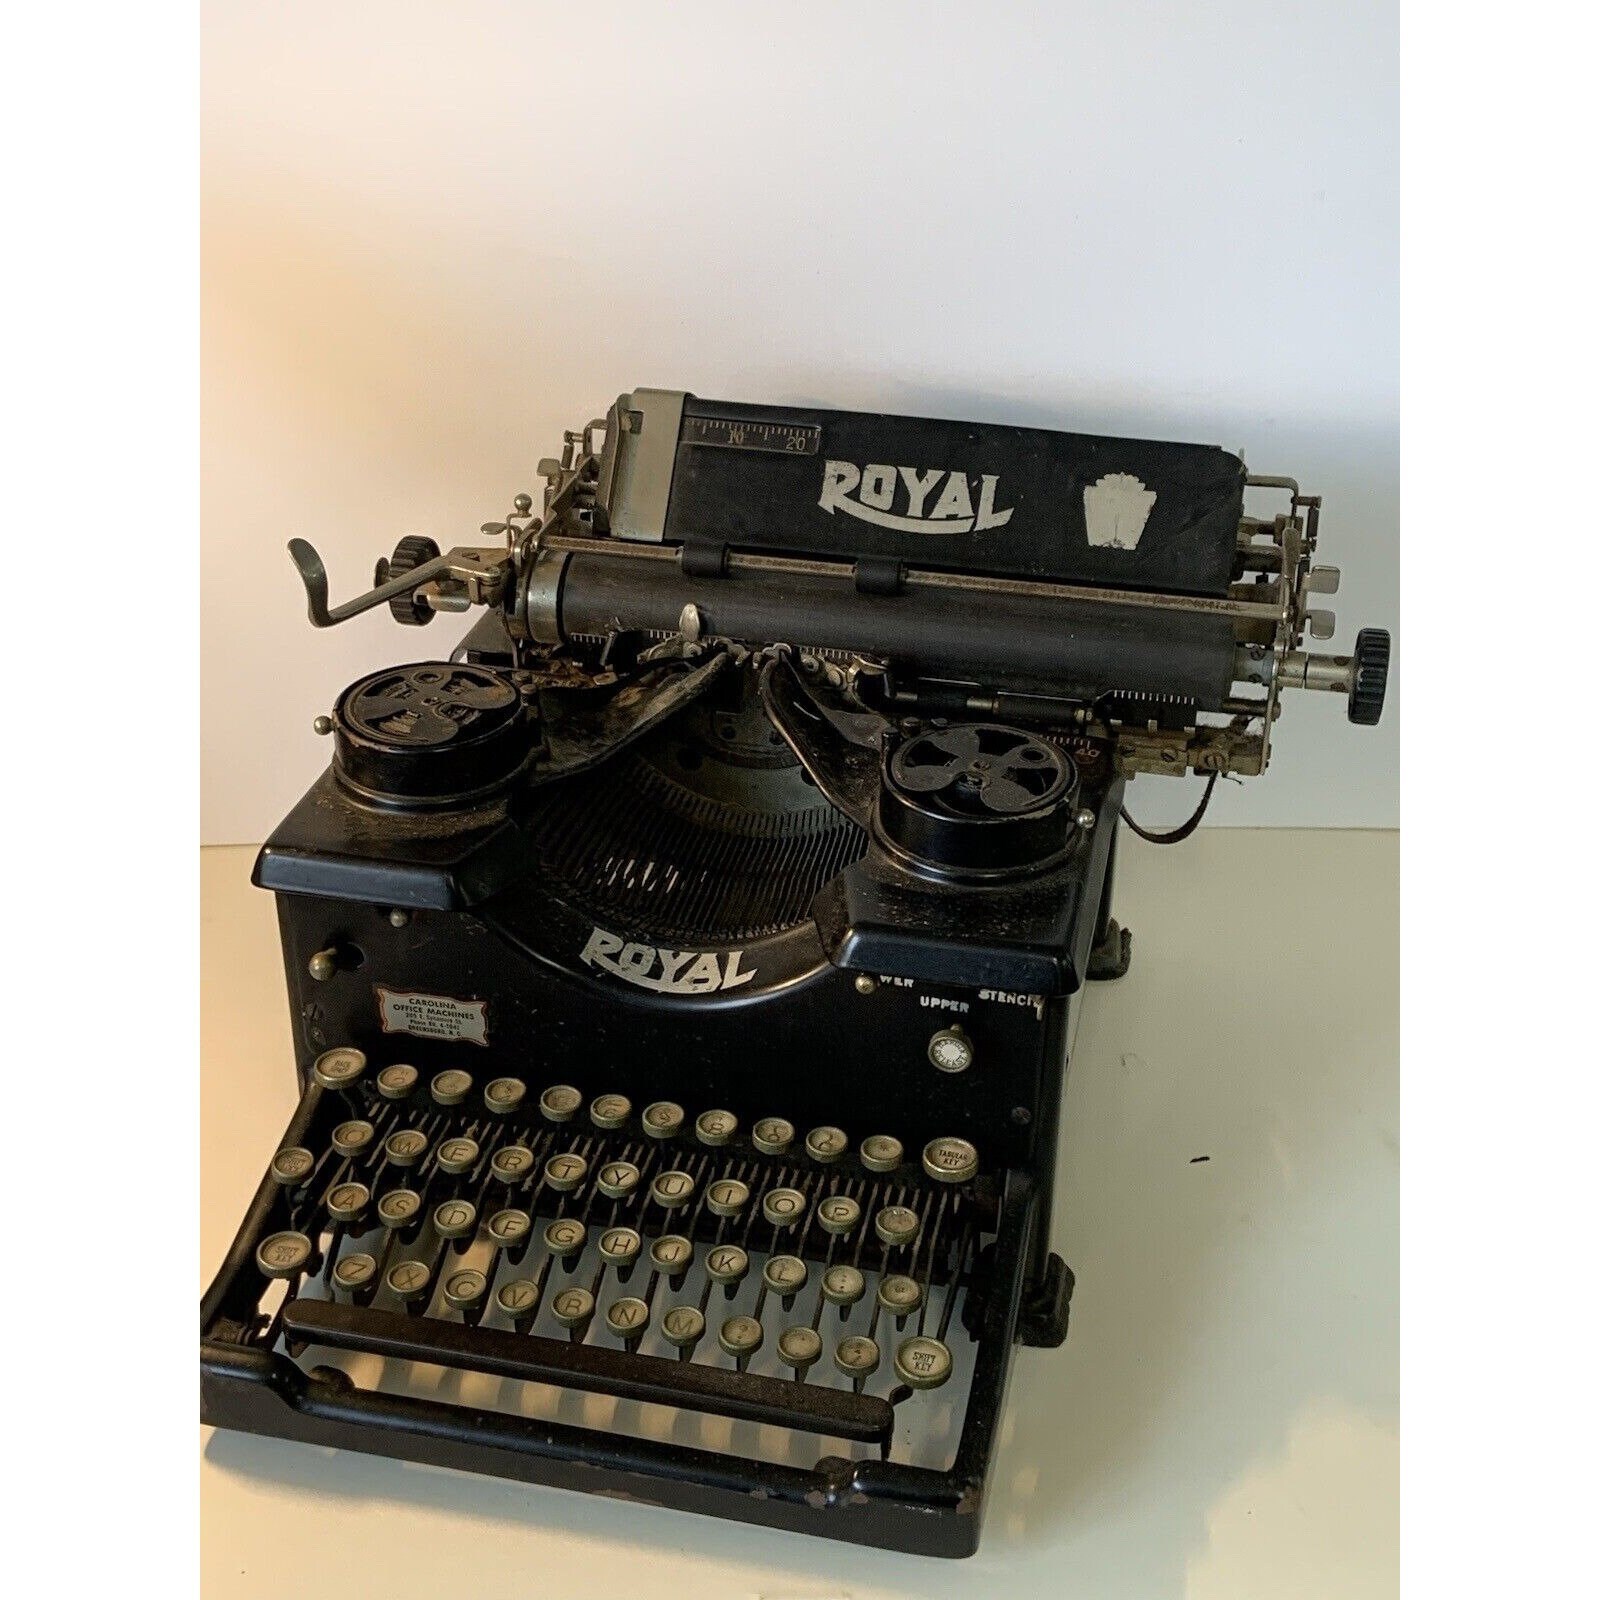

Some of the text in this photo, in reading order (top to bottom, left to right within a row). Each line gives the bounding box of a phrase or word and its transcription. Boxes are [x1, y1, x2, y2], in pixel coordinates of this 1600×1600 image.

[817, 459, 1014, 535] ROYAL
[579, 926, 758, 995] ROYAL
[393, 1003, 475, 1020] OFFICE MACHINES
[408, 998, 457, 1010] CAROLINA
[920, 996, 969, 1013] UPPER
[504, 1156, 522, 1169] R
[559, 1164, 575, 1178] T
[614, 1170, 630, 1185] Y
[665, 1178, 685, 1195] U
[337, 1194, 355, 1208] A
[775, 1198, 795, 1214] O
[448, 1210, 467, 1225] D
[502, 1220, 522, 1236] F
[555, 1227, 576, 1244] G
[611, 1237, 631, 1253] H
[665, 1246, 680, 1261] J
[718, 1255, 736, 1272] K
[400, 1269, 421, 1287] X
[457, 1281, 476, 1297] C
[511, 1290, 528, 1306] V
[565, 1298, 582, 1313] B
[616, 1307, 637, 1325] N
[673, 1315, 693, 1333] M
